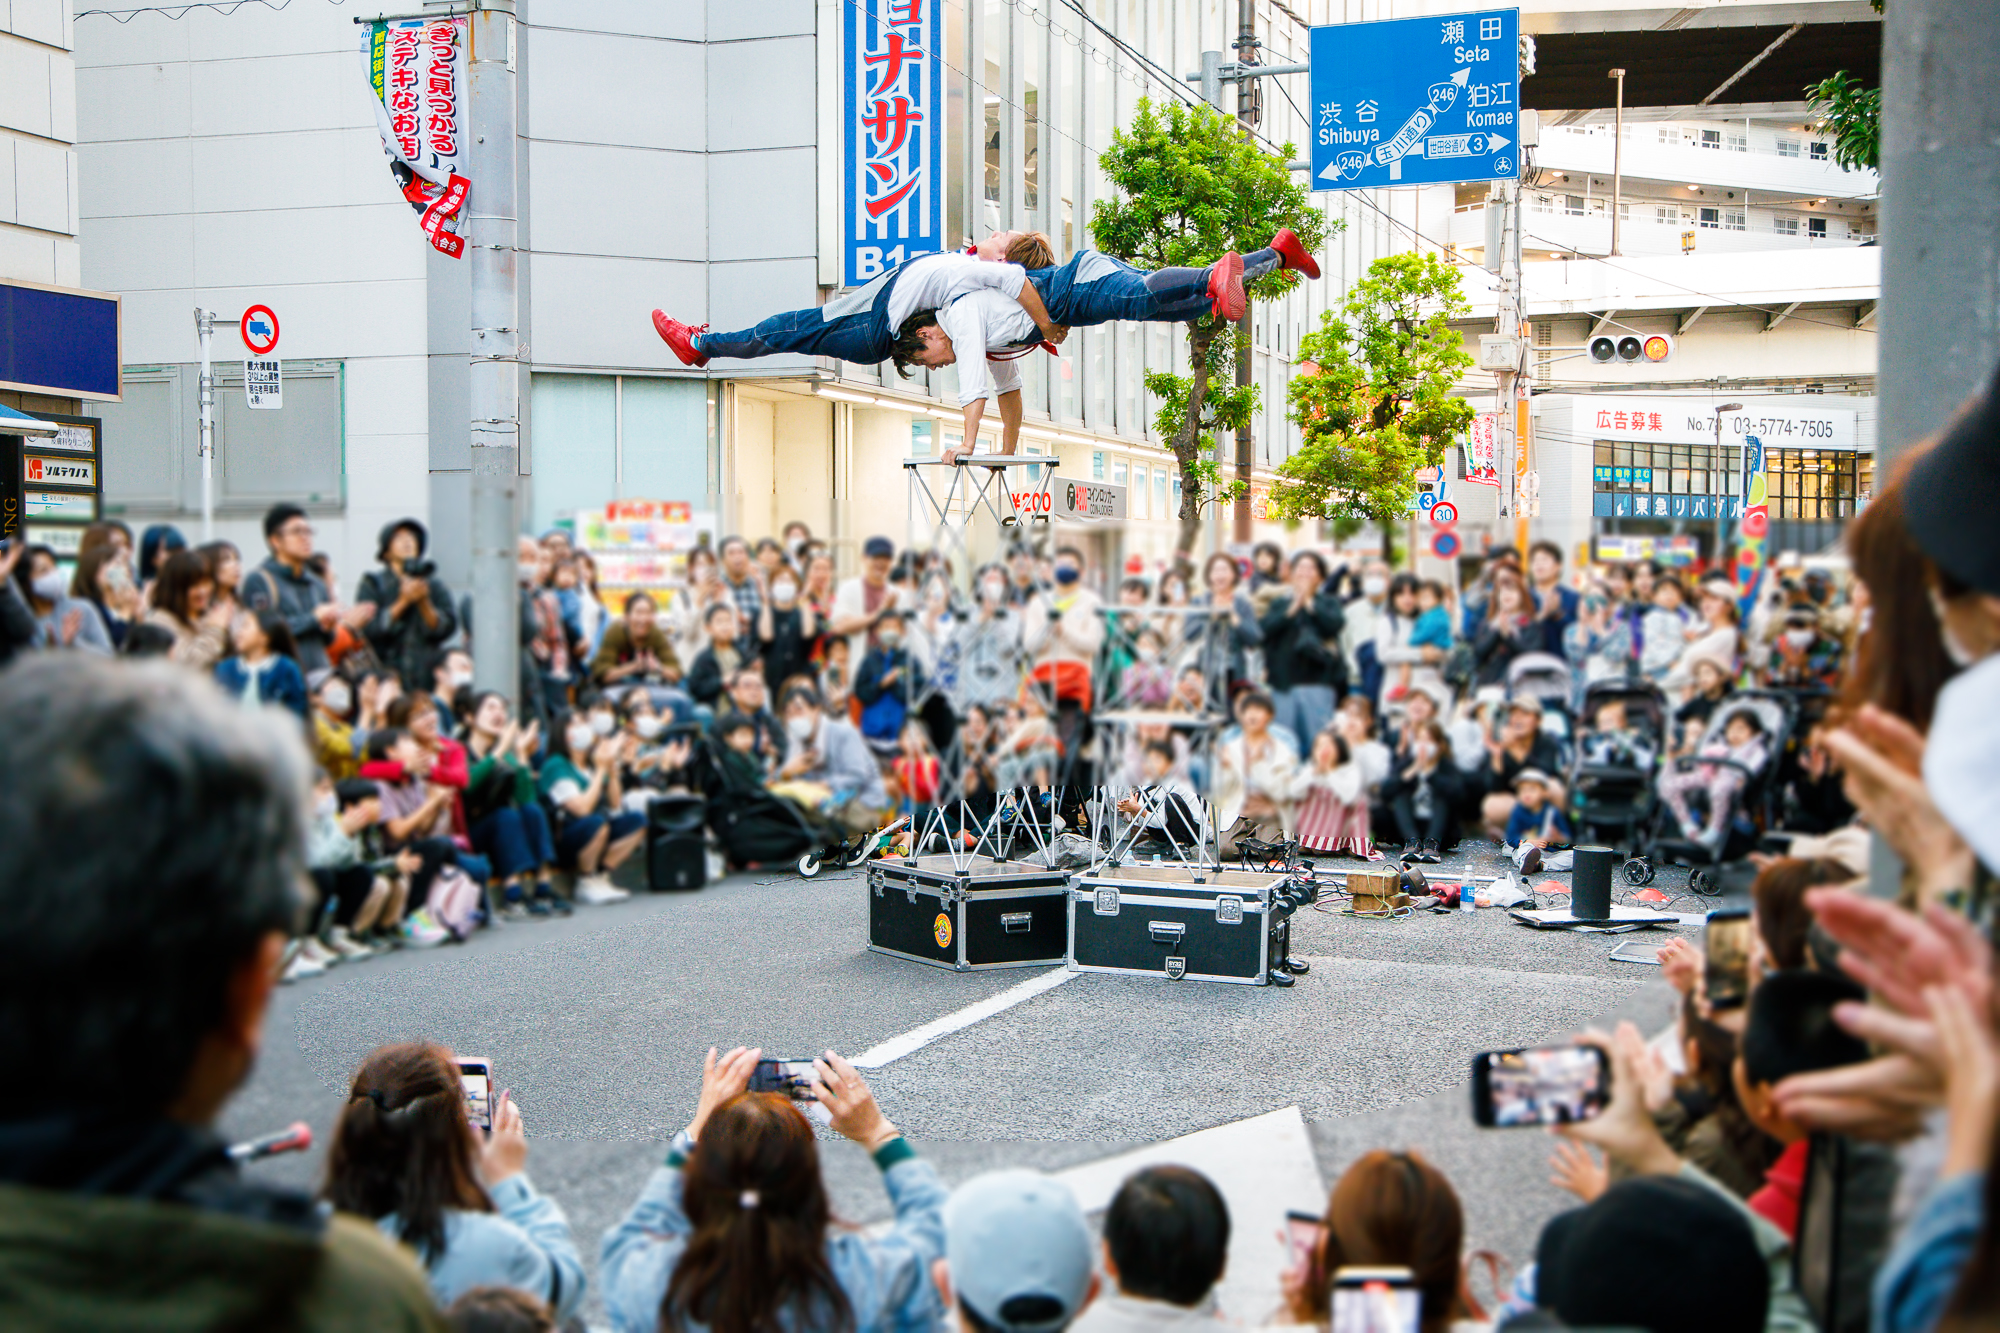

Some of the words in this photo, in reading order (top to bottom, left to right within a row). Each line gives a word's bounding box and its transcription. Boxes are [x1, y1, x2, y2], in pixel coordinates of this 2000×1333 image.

[1441, 17, 1501, 44] 瀬田
[1454, 45, 1490, 64] Seta
[391, 28, 421, 160] ステキなお店
[1432, 87, 1455, 103] 246
[1467, 82, 1512, 108] 狛江
[1319, 99, 1379, 126] 渋谷
[1466, 110, 1514, 128] Komae
[1318, 127, 1380, 146] Shibuya
[1379, 114, 1428, 162] 玉川通り
[1473, 137, 1483, 151] 3
[1429, 138, 1466, 155] 世田谷通り
[1341, 154, 1362, 170] 246
[856, 244, 930, 281] B1
[247, 361, 279, 371] 最大積載量
[1596, 409, 1663, 431] 広告募集
[1733, 416, 1833, 438] 03-5774-7505
[45, 466, 89, 478] ソルテクノス
[1011, 492, 1052, 512] ¥200
[1087, 487, 1116, 505] コインロッカー
[1423, 495, 1433, 508] 3
[1436, 509, 1452, 521] 30
